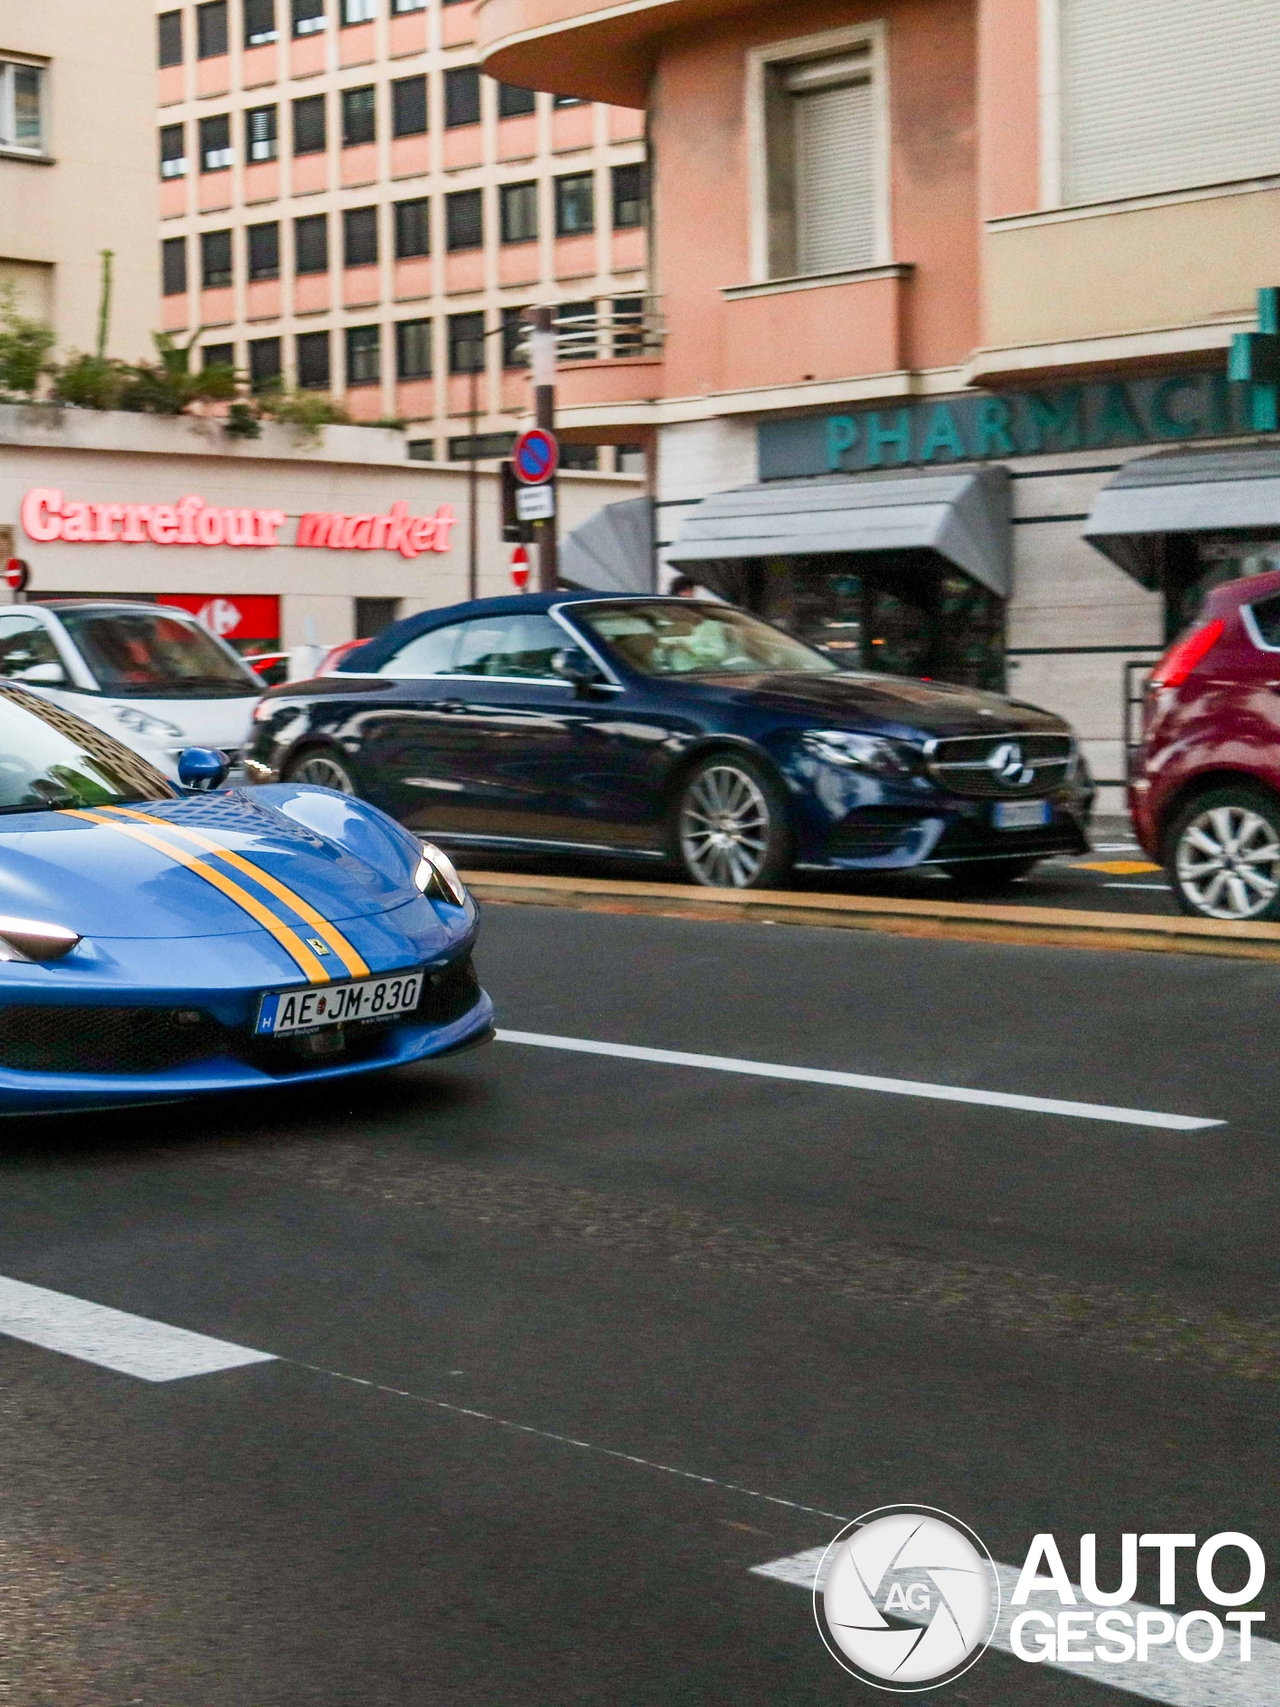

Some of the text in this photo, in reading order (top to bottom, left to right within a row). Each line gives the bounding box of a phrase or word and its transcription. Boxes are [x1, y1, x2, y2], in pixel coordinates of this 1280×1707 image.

[825, 374, 1256, 471] PHARMACI
[21, 487, 458, 559] Carrefour market
[262, 1017, 271, 1028] H
